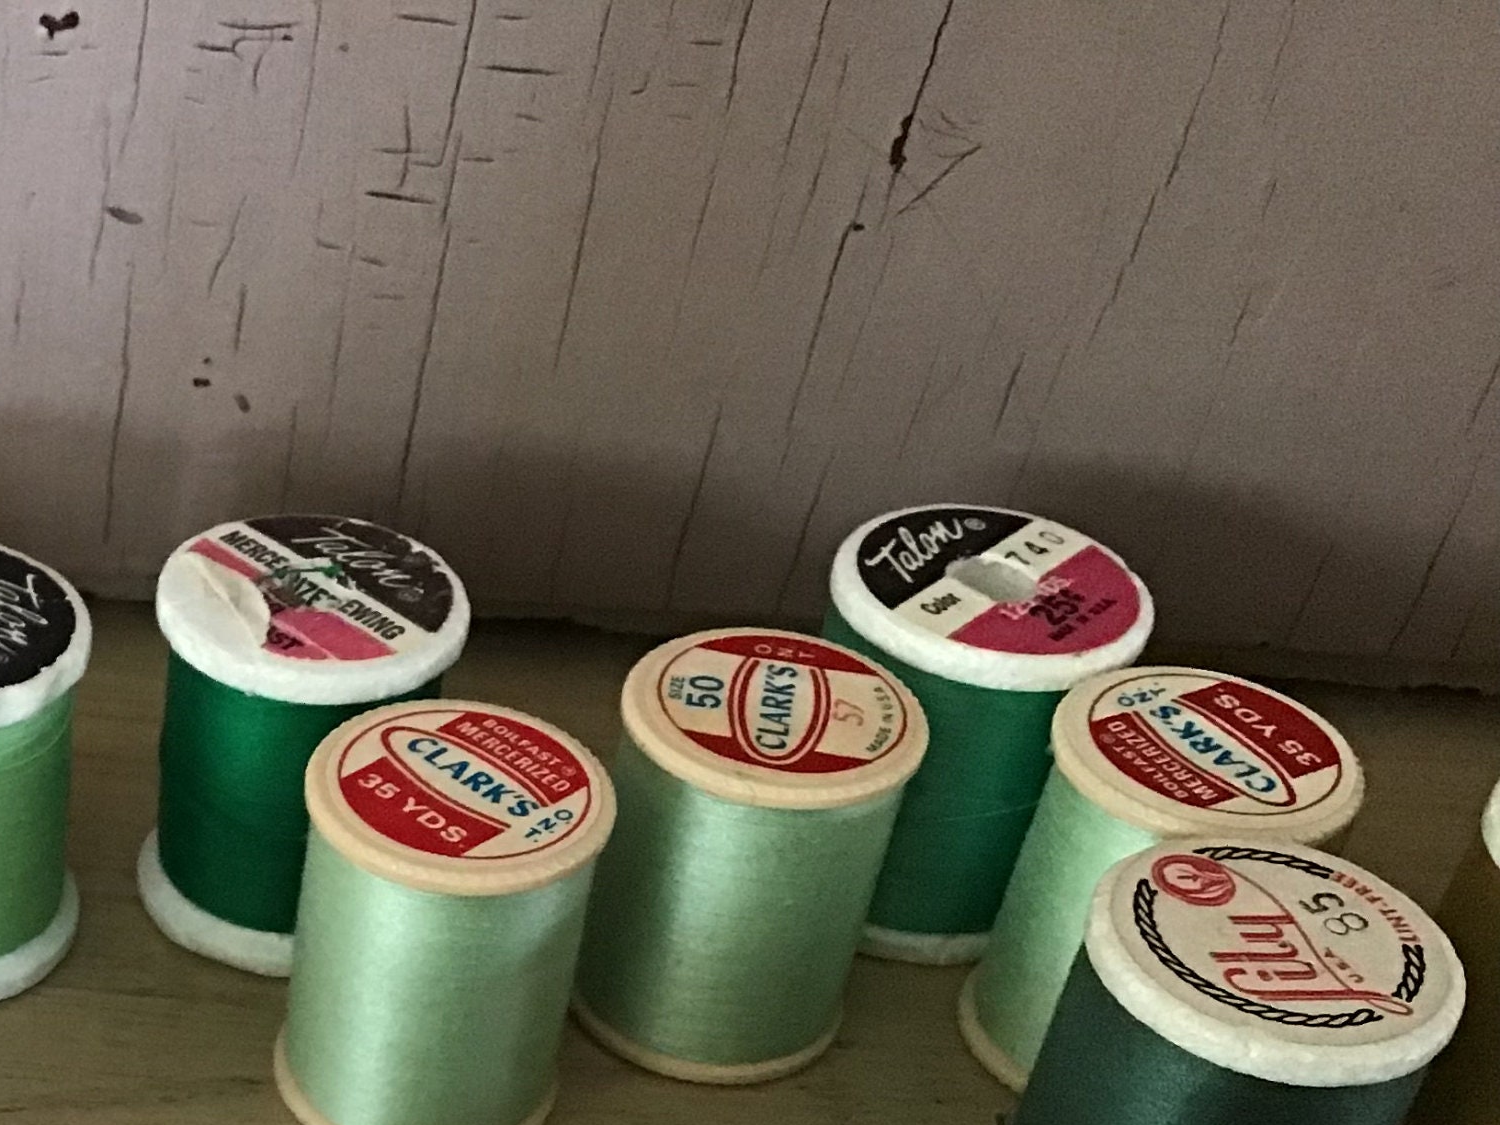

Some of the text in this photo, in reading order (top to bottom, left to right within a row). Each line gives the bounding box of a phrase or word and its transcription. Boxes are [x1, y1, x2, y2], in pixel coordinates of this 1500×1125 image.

[290, 526, 410, 589] Talon
[864, 518, 963, 583] Talon
[920, 530, 1065, 615] Color 740
[340, 600, 406, 640] EWING
[668, 675, 685, 700] SIZE
[685, 675, 724, 709] 50
[755, 664, 798, 750] CLARK'S
[455, 721, 571, 793] MERCERIZED
[482, 718, 562, 766] BOILFAST
[866, 726, 893, 753] MADE
[1107, 720, 1218, 801] MERCERIZED
[1149, 704, 1277, 793] CLARK'S
[1276, 739, 1322, 767] 35
[358, 773, 400, 800] 35
[407, 737, 541, 818] CLARK'S
[1112, 744, 1189, 800] BOILFAST
[1299, 892, 1369, 936] 85
[1331, 871, 1421, 944] LINT-FREE
[1209, 914, 1413, 1016] Lily
